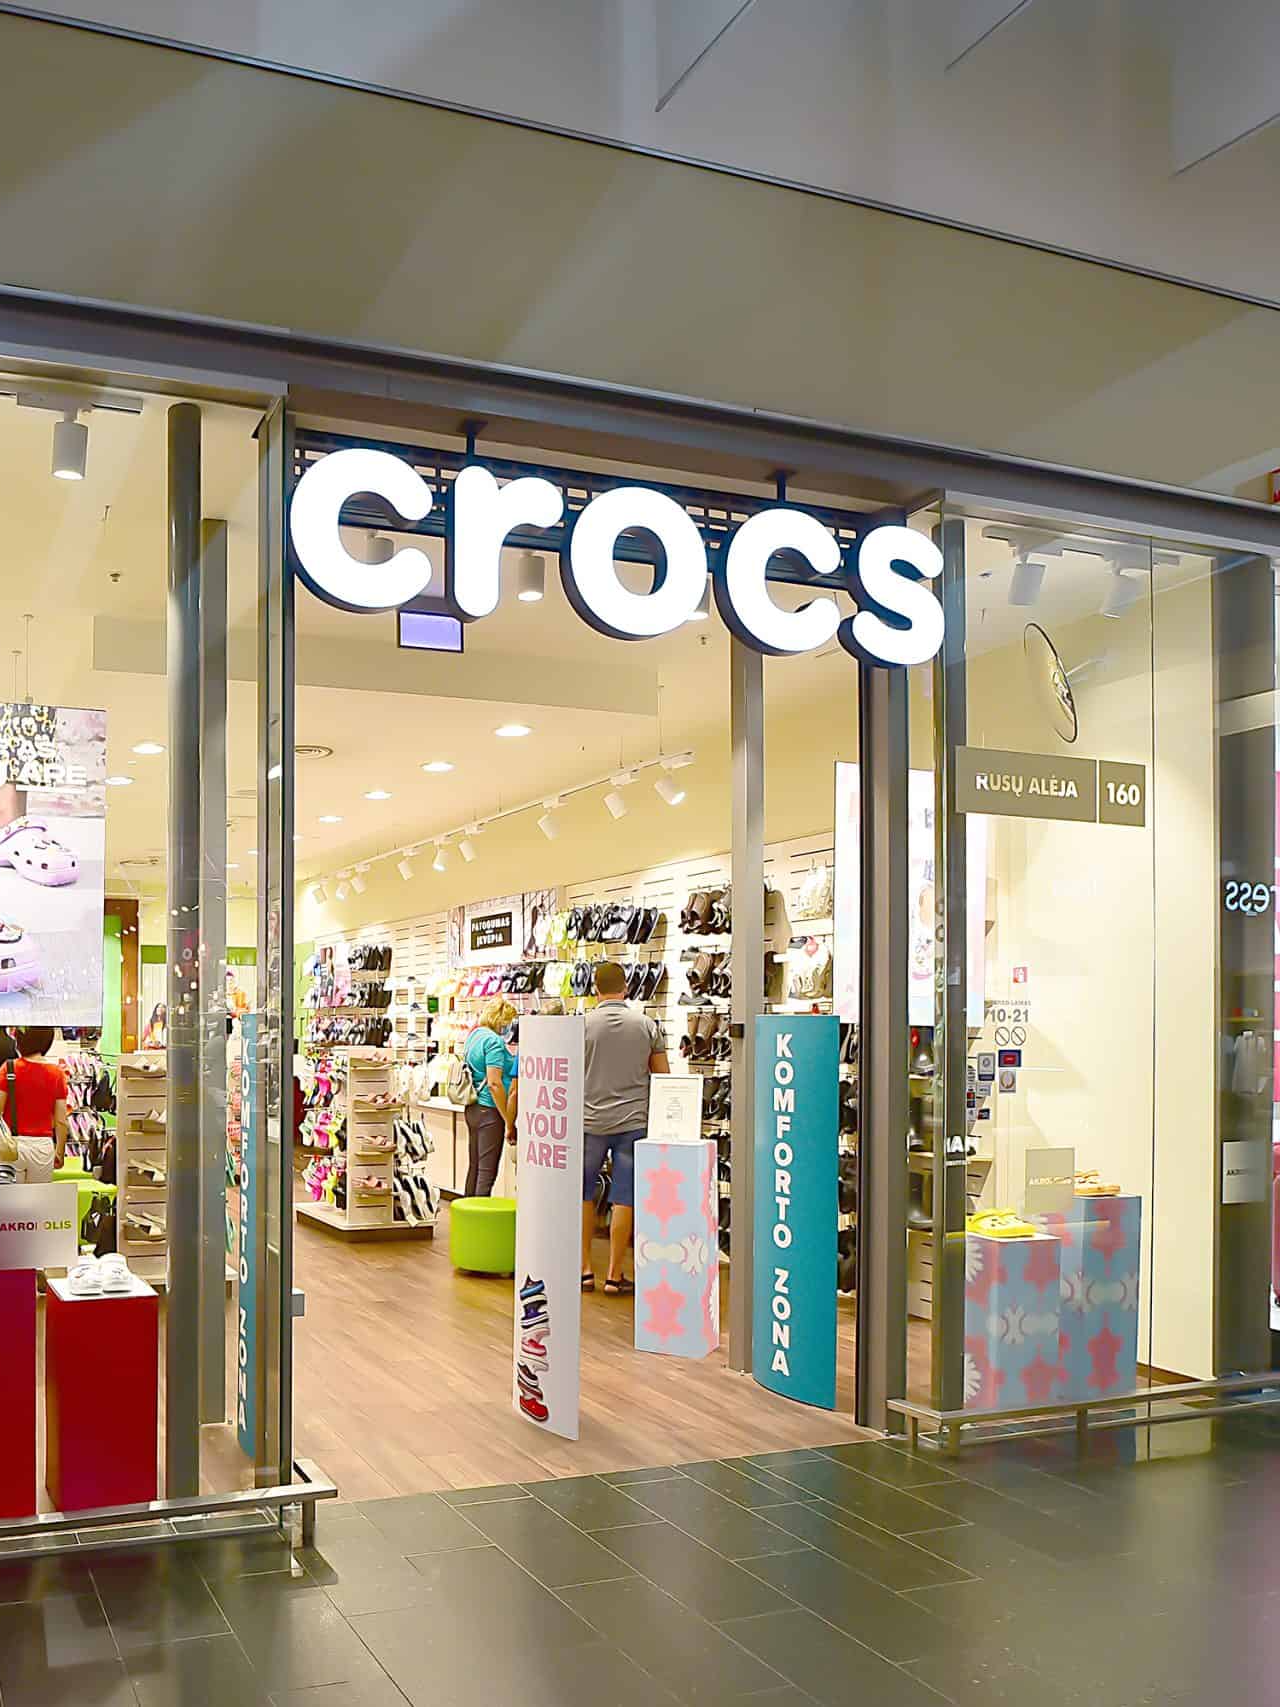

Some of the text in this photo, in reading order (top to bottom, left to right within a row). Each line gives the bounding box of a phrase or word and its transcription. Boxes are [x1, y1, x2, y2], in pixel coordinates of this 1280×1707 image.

[289, 447, 946, 667] crocs
[1028, 774, 1079, 798] ALĖJA
[1106, 782, 1141, 806] 160
[535, 1085, 568, 1112] AS
[525, 1112, 568, 1141] YOU
[525, 1141, 568, 1170] ARE
[770, 1033, 795, 1377] KOMFORTO ZONA
